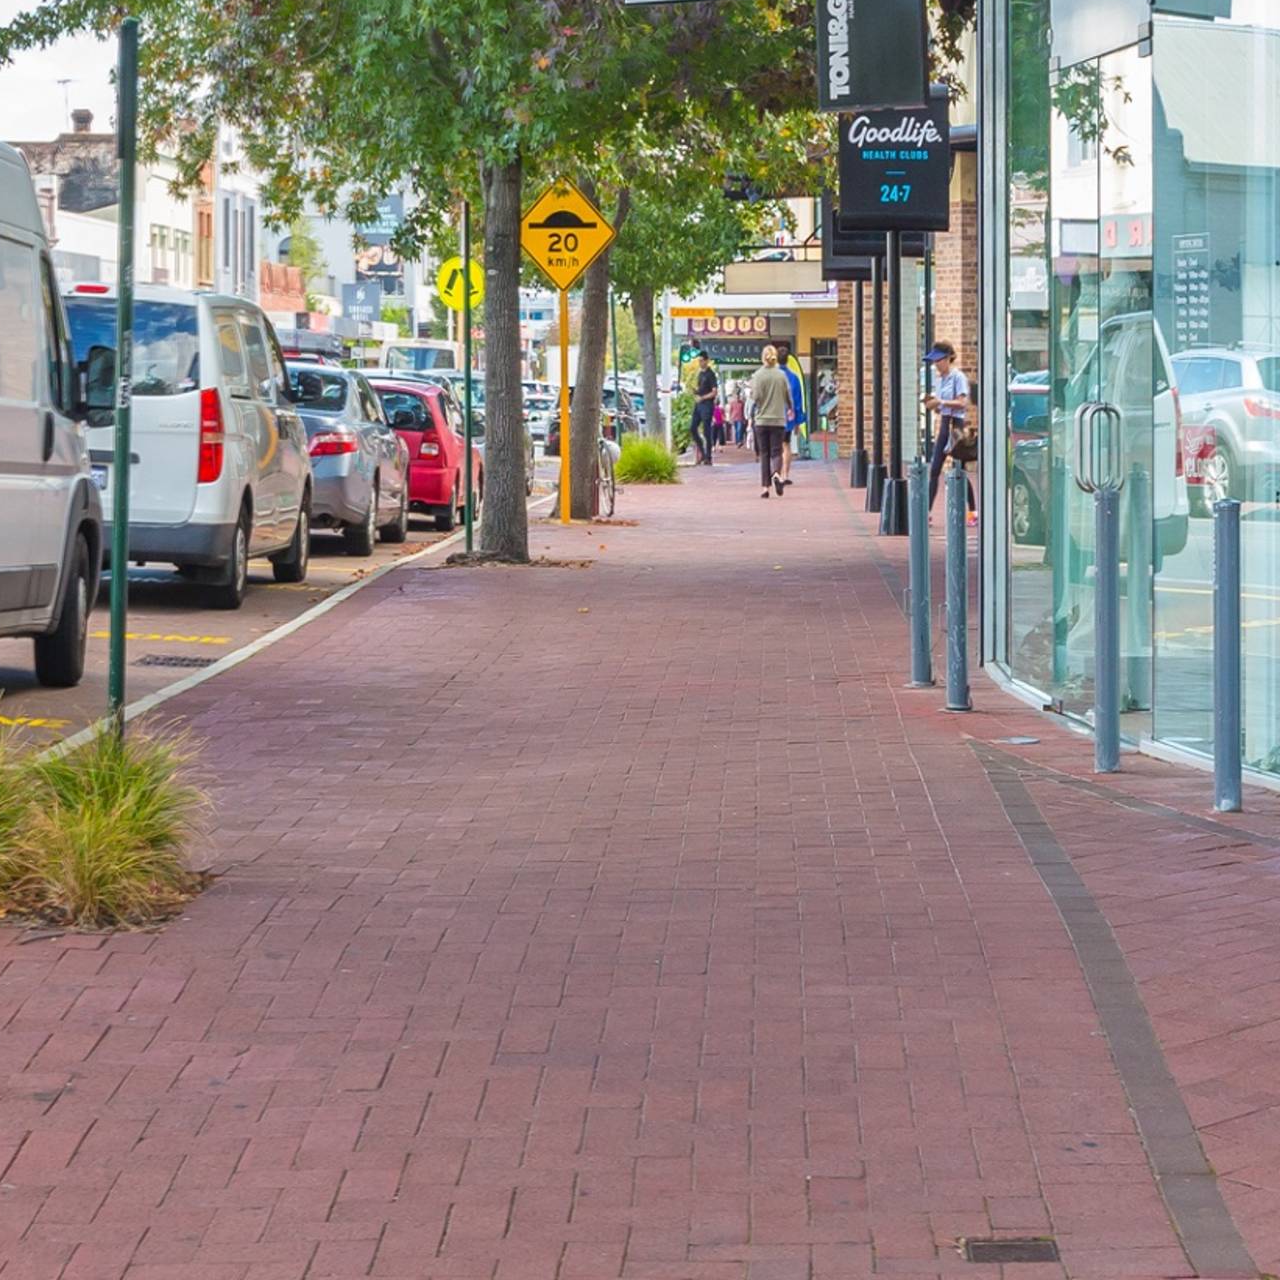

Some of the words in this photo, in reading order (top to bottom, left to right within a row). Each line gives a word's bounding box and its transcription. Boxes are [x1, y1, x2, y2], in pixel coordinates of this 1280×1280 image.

[862, 150, 897, 160] HEALTH
[899, 150, 929, 160] CLUBS
[547, 233, 579, 252] 20
[547, 257, 580, 269] km/h
